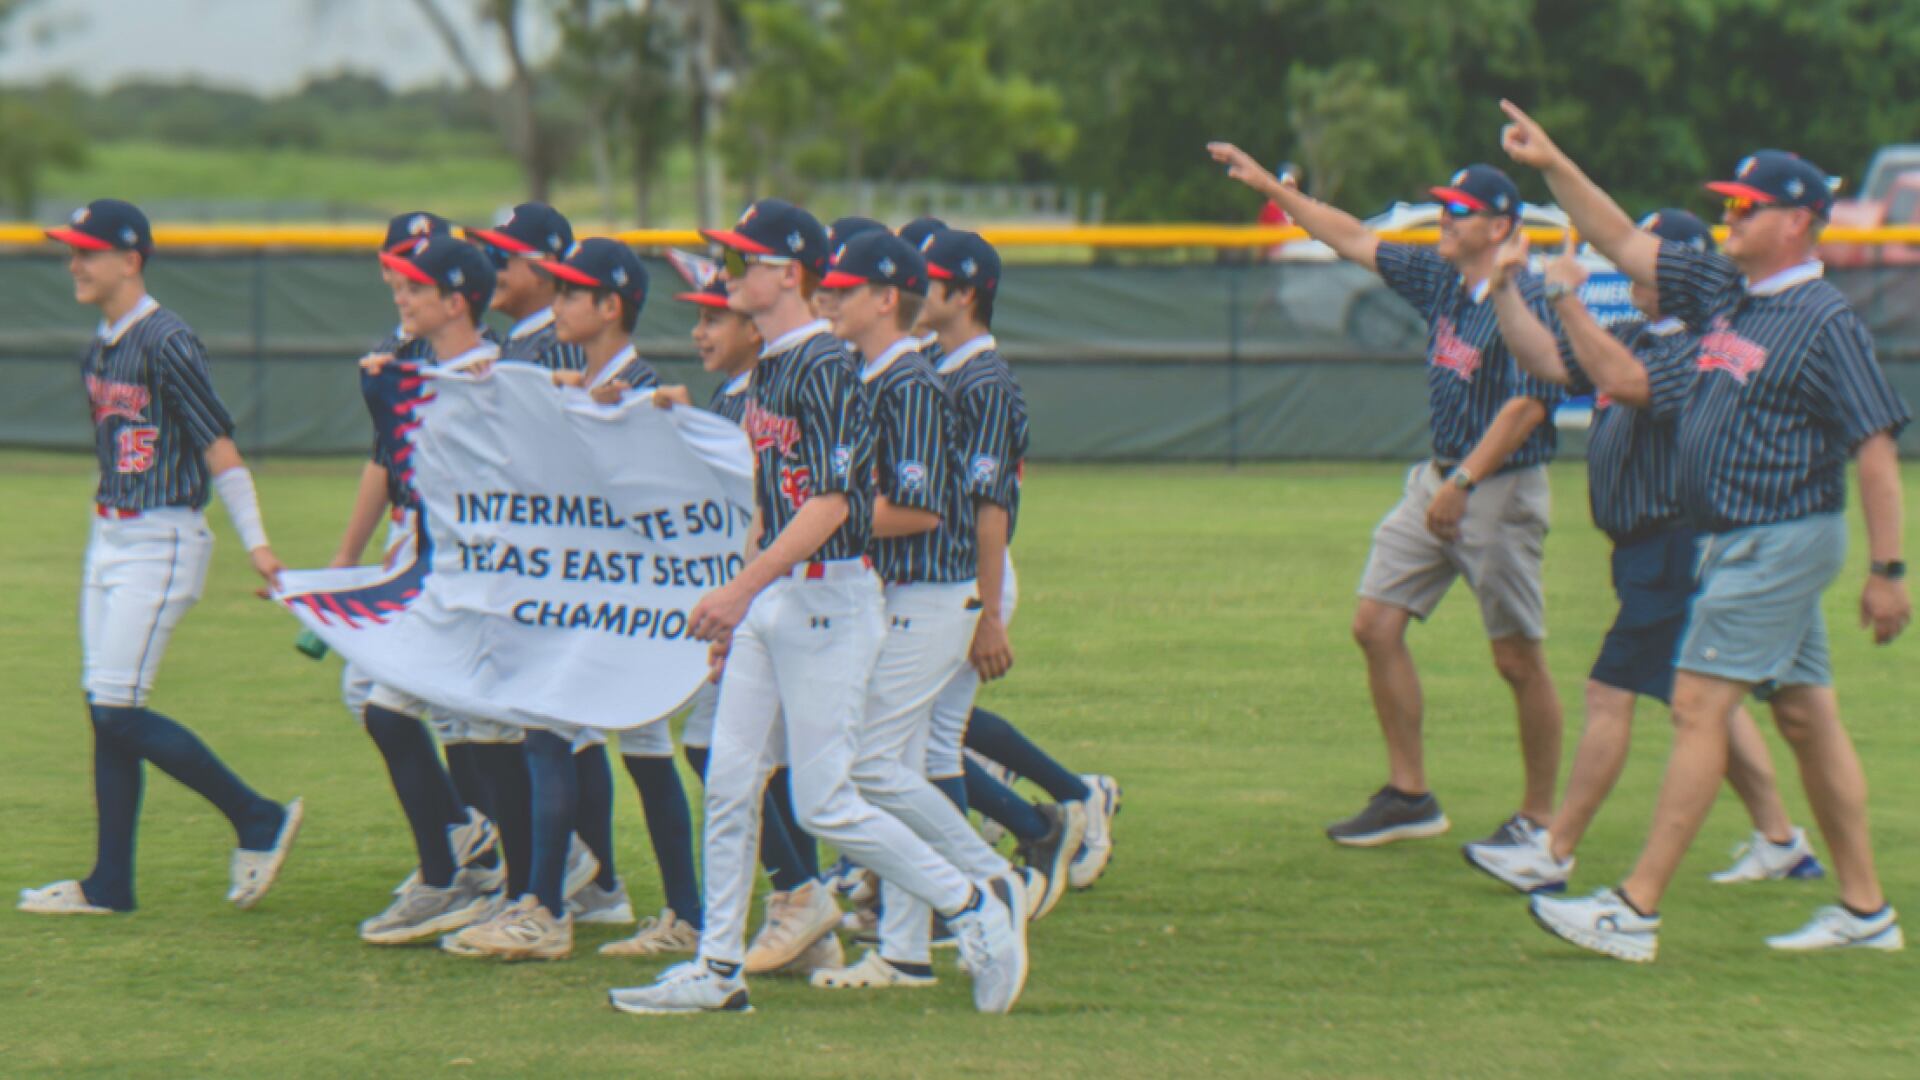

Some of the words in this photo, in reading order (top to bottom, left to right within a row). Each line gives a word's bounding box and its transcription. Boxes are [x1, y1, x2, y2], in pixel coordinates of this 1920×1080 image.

[116, 426, 158, 473] 15
[455, 491, 679, 541] INTERMETE
[562, 548, 643, 584] EAST
[653, 553, 745, 587] SECTIO
[512, 600, 694, 640] CHAMPIO
